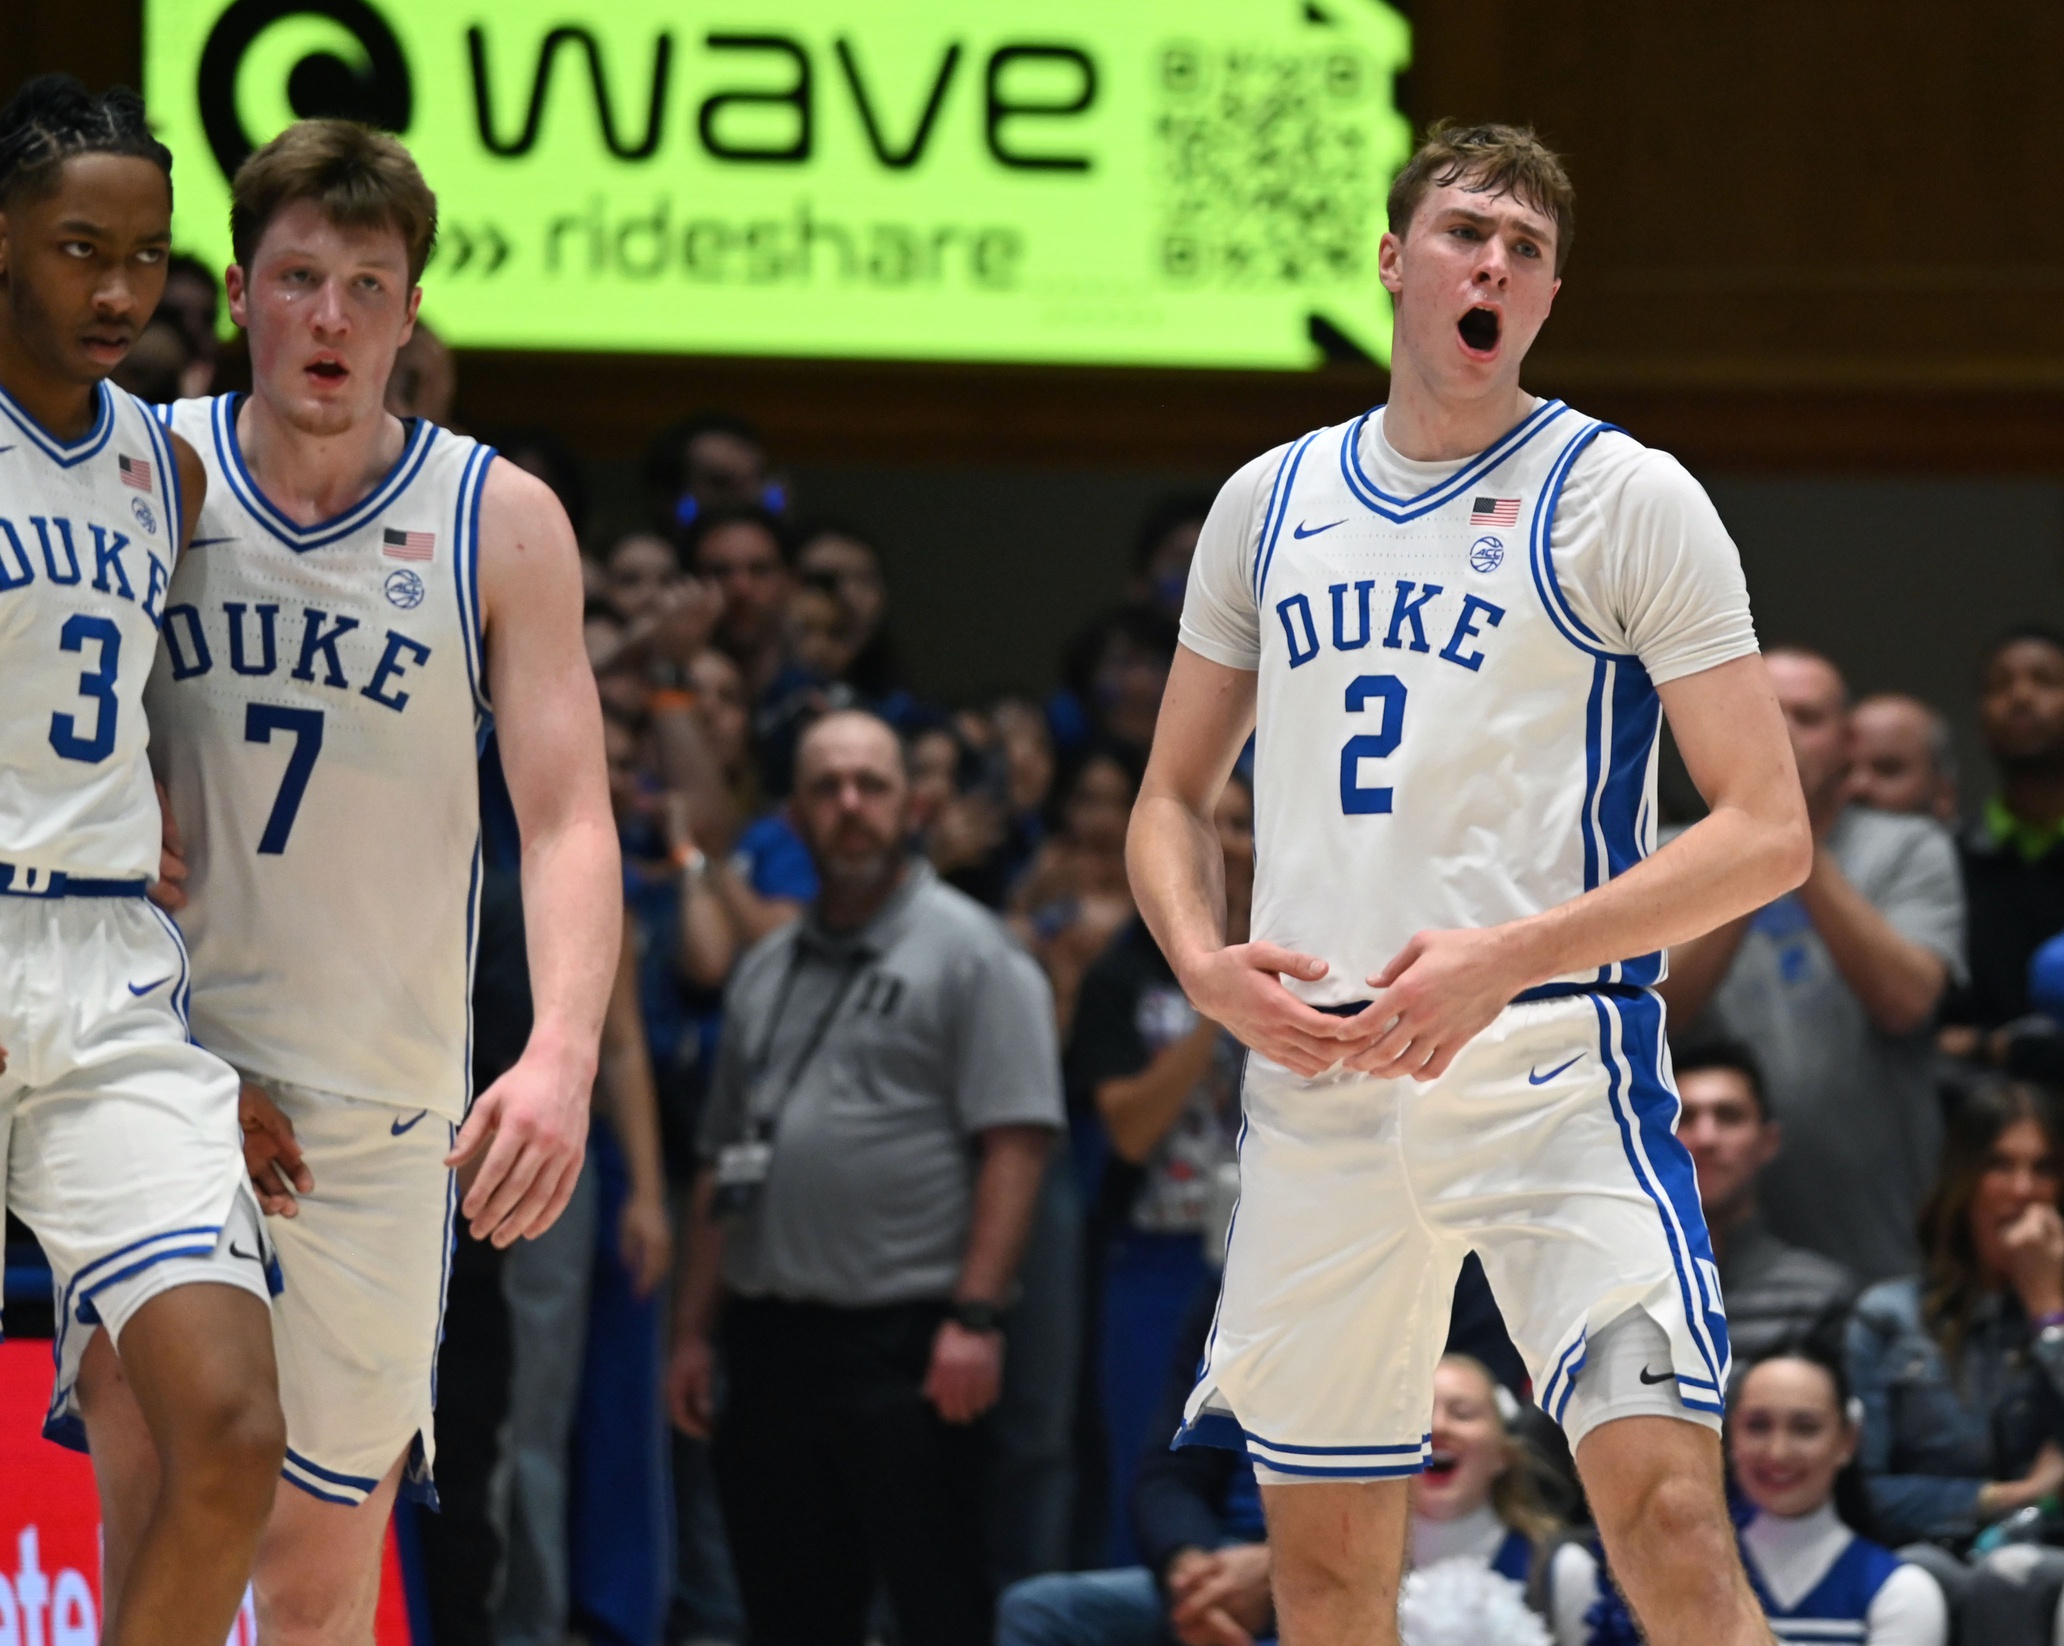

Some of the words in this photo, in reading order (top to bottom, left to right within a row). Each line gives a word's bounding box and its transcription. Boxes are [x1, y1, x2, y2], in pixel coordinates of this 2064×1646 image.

[465, 22, 1098, 170] wave
[544, 196, 1022, 290] rideshare
[0, 515, 168, 631] DUKE
[1276, 580, 1506, 672] DUKE
[48, 613, 122, 764] 3
[163, 602, 432, 713] DUKE
[244, 702, 325, 855] 7
[1340, 674, 1408, 816] 2
